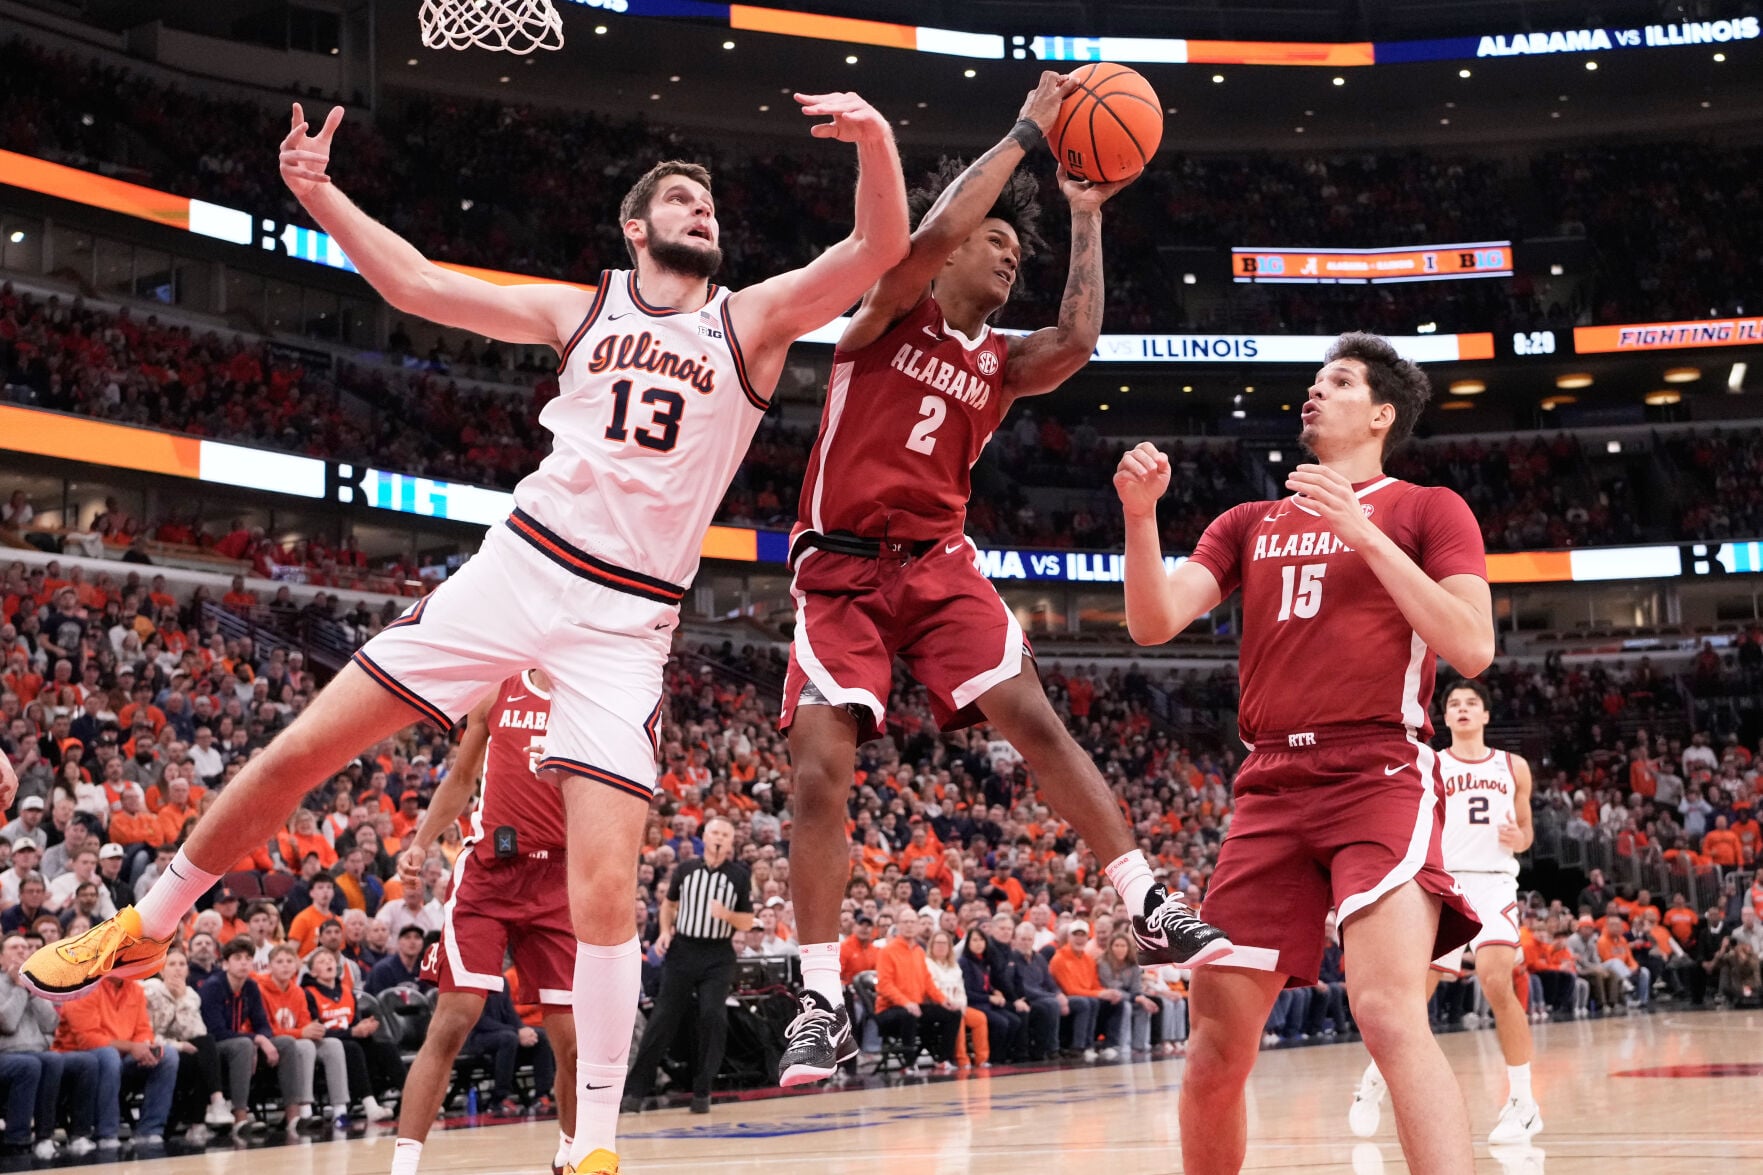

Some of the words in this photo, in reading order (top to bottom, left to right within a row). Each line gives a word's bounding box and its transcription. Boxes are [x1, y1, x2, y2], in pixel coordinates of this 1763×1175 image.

[1477, 29, 1612, 57] ALABAMA
[1614, 30, 1641, 46] VS
[1644, 17, 1760, 47] ILLINOIS
[1619, 322, 1734, 347] FIGHTING
[1739, 320, 1763, 339] IL
[1142, 339, 1258, 357] ILLINOIS
[588, 331, 715, 395] Illinois
[979, 352, 997, 374] SEC
[890, 343, 991, 411] ALABAMA
[604, 379, 686, 453] 13
[905, 395, 947, 456] 2
[1030, 554, 1060, 576] VS
[1278, 563, 1327, 621] 15
[499, 710, 547, 730] ALAB
[1288, 732, 1317, 747] RTR
[1446, 772, 1507, 797] Illinois
[1468, 796, 1490, 824] 2
